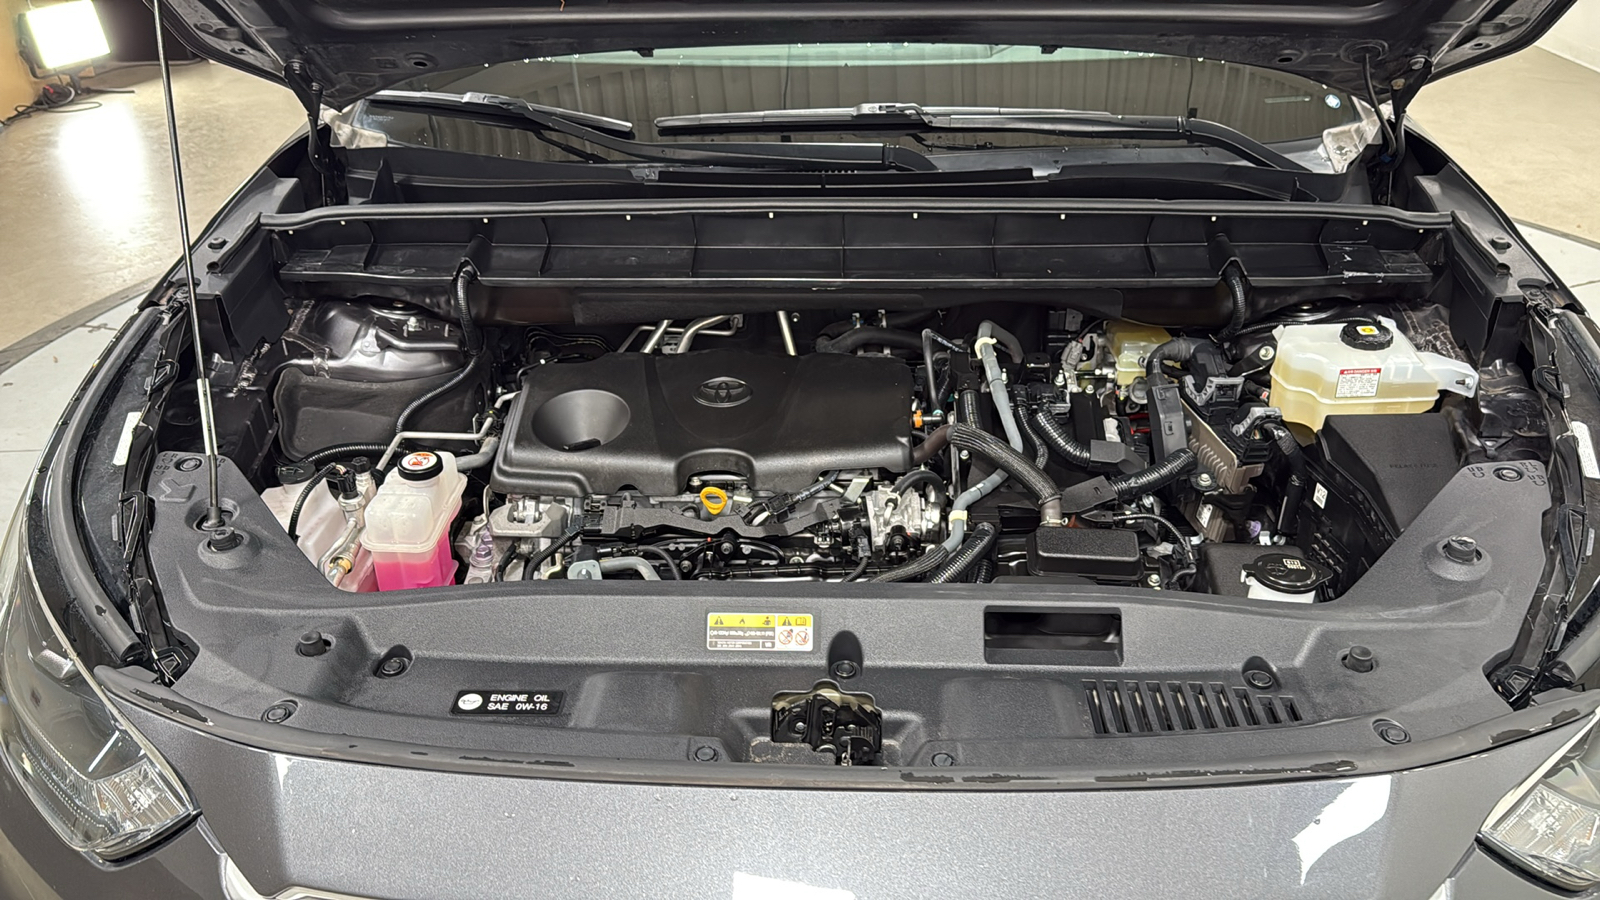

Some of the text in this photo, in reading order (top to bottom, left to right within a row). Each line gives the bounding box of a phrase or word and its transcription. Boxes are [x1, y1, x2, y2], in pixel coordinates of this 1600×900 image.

[490, 694, 550, 702] ENGINE OIL
[487, 702, 548, 711] SAE 0W-16
